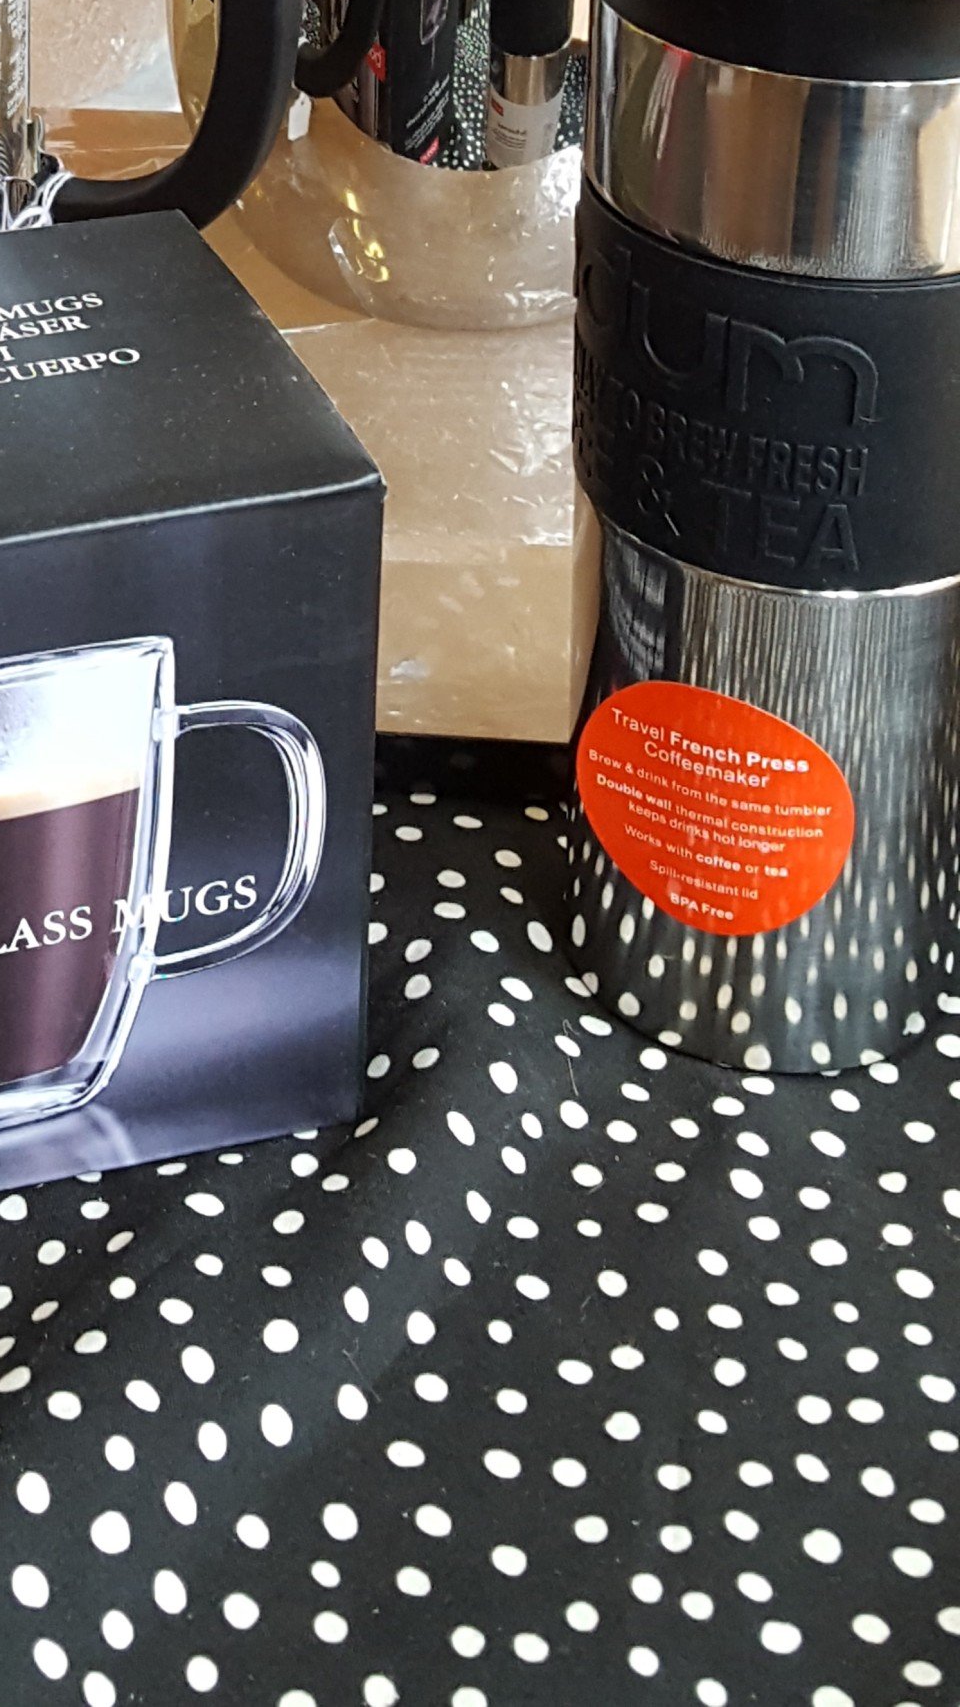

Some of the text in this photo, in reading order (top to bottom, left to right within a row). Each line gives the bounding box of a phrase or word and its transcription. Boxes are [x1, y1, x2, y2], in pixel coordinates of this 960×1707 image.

[581, 242, 881, 427] dum
[746, 432, 871, 499] FRESH
[699, 477, 861, 575] TEA
[611, 706, 810, 773] Travel French Press
[644, 740, 771, 788] Coffeemaker
[588, 748, 833, 817] Brew & drink from the same tumbler
[596, 773, 824, 838] Double wall thermal construction
[624, 822, 789, 878] Works with coffee or tea
[628, 799, 787, 854] keeps drinks hot longer
[111, 874, 259, 936] MUGS
[649, 859, 759, 901] Spill-resistant lid
[670, 891, 735, 921] BPA Free
